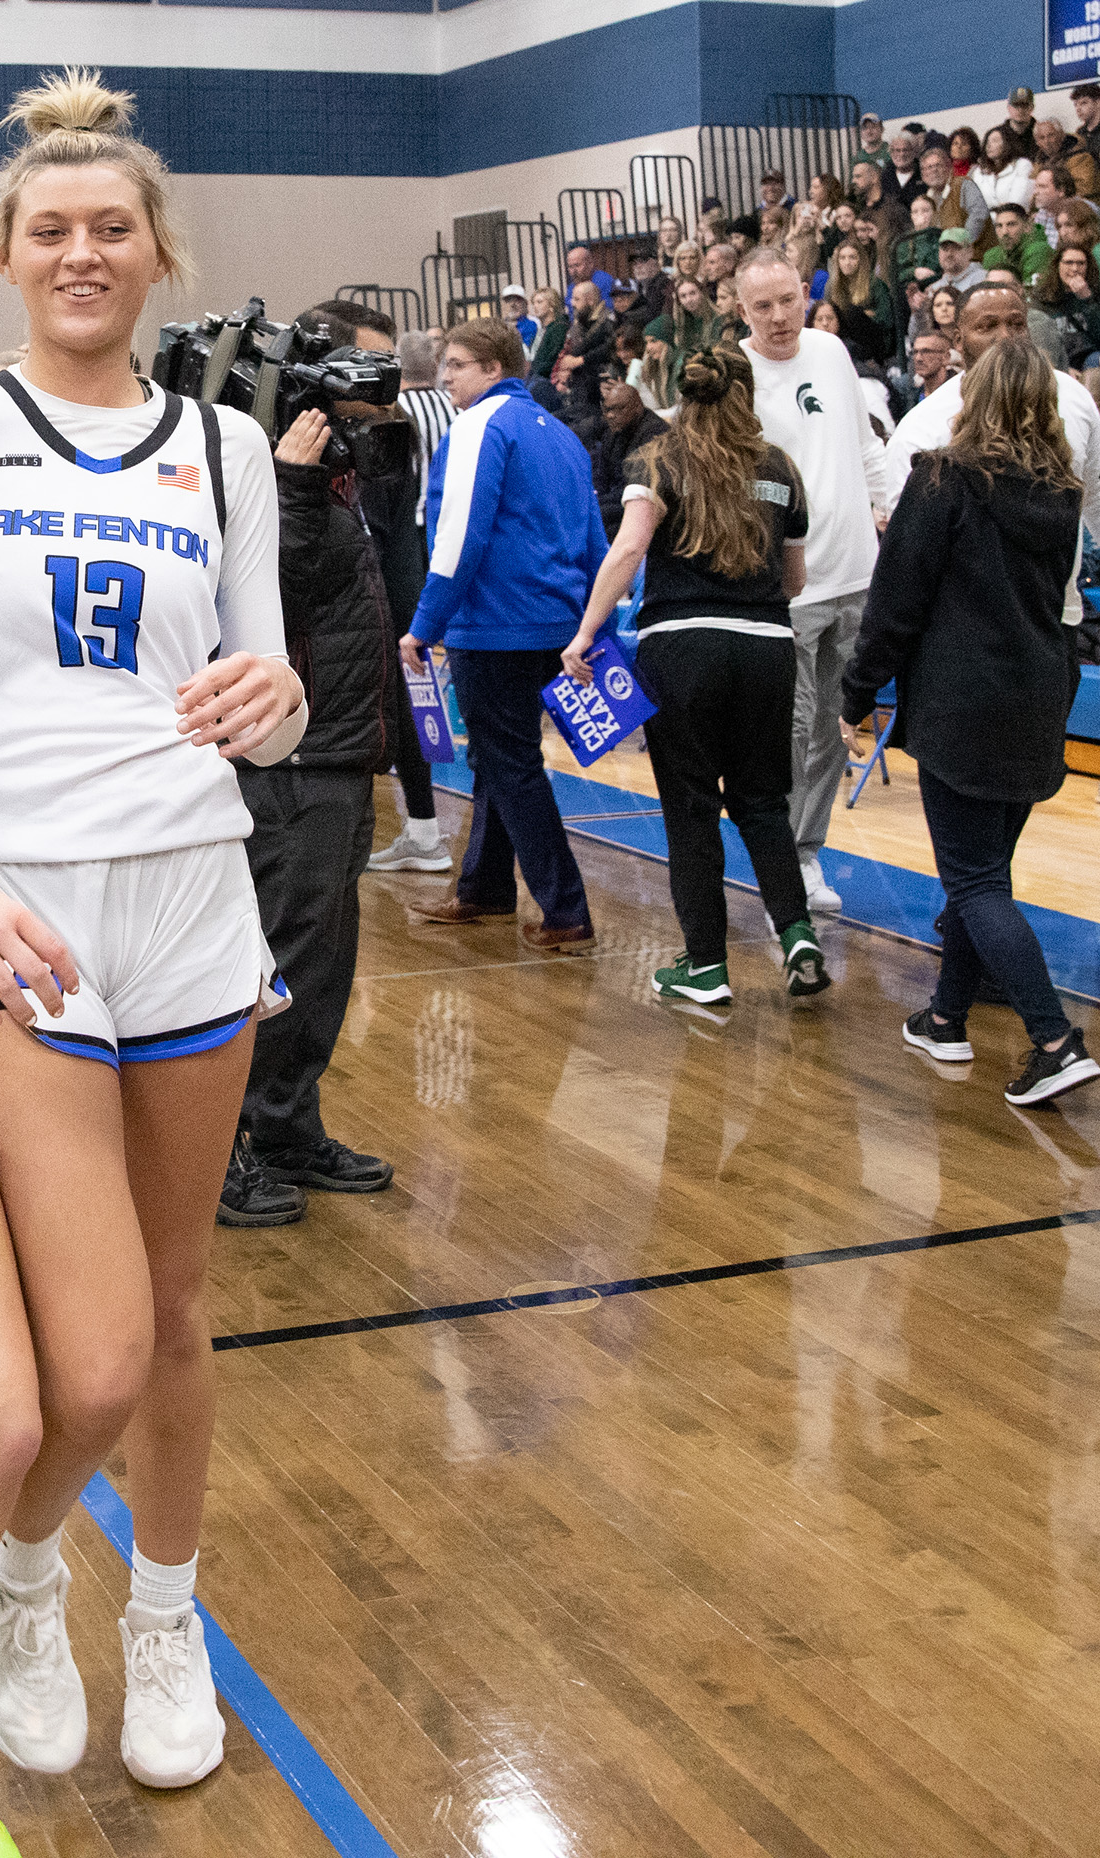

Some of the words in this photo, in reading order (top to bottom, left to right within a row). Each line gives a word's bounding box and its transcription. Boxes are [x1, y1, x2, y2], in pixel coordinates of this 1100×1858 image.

[73, 512, 208, 568] FENTON
[45, 554, 145, 675] 13
[553, 679, 605, 752] COACH
[571, 678, 621, 739] KAR
